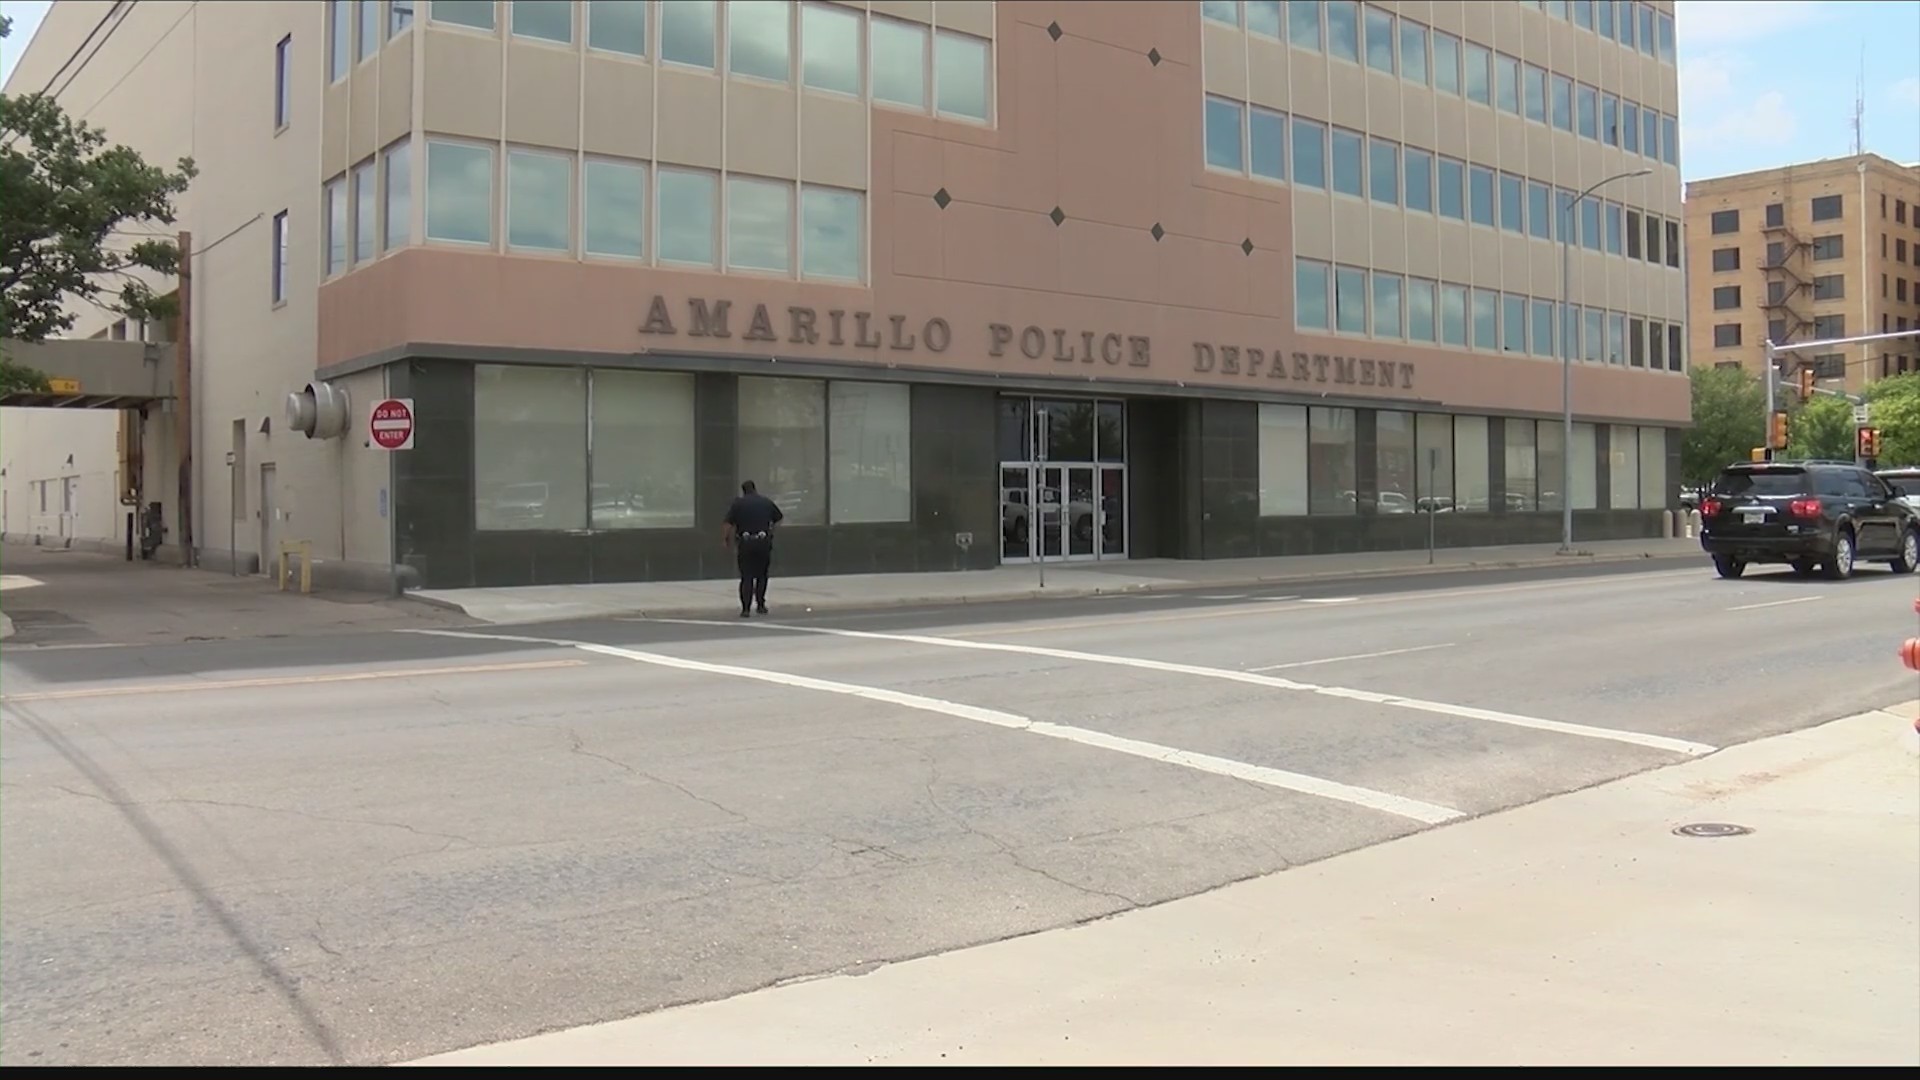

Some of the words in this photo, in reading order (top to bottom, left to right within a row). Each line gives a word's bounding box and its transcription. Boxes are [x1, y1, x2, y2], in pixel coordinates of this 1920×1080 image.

[638, 295, 951, 352] AMARILLO
[989, 324, 1152, 367] POLICE
[1193, 341, 1416, 389] DEPARTMENT
[376, 410, 389, 418] DO
[390, 409, 407, 418] NOT
[379, 430, 404, 440] ENTER
